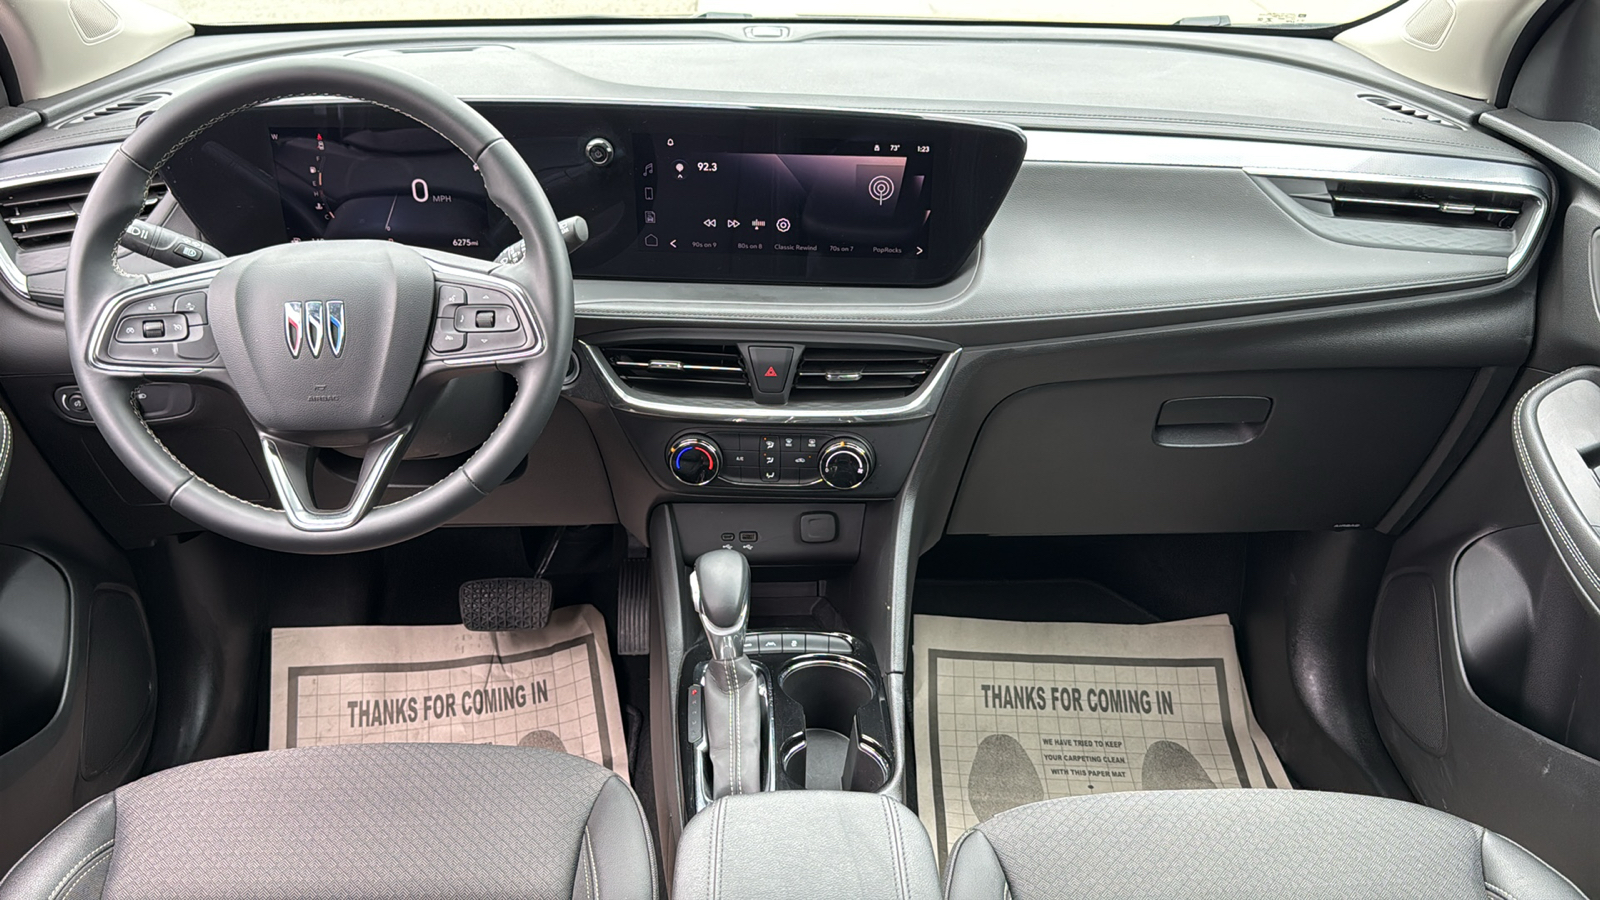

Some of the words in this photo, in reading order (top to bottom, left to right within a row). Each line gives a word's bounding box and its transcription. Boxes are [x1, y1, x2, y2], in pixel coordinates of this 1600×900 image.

[917, 145, 930, 153] 1:23
[697, 162, 718, 172] 92.3
[411, 178, 429, 203] 0
[452, 239, 479, 247] 6275mi
[774, 243, 795, 251] Classic
[872, 246, 902, 254] PopRocks
[347, 697, 418, 728] THANKS
[423, 693, 457, 721] FOR
[461, 684, 526, 716] COMING
[530, 679, 549, 704] IN
[981, 684, 1047, 711] THANKS
[1050, 687, 1084, 712] FOR
[1086, 688, 1151, 715] COMING
[1155, 690, 1175, 715] IN
[1042, 738, 1053, 746] WE
[1054, 739, 1073, 747] HAVE
[1073, 739, 1093, 747] TRIED
[1094, 740, 1104, 748] TO
[1063, 755, 1102, 763] CARPETING
[1102, 756, 1126, 764] CLEAN
